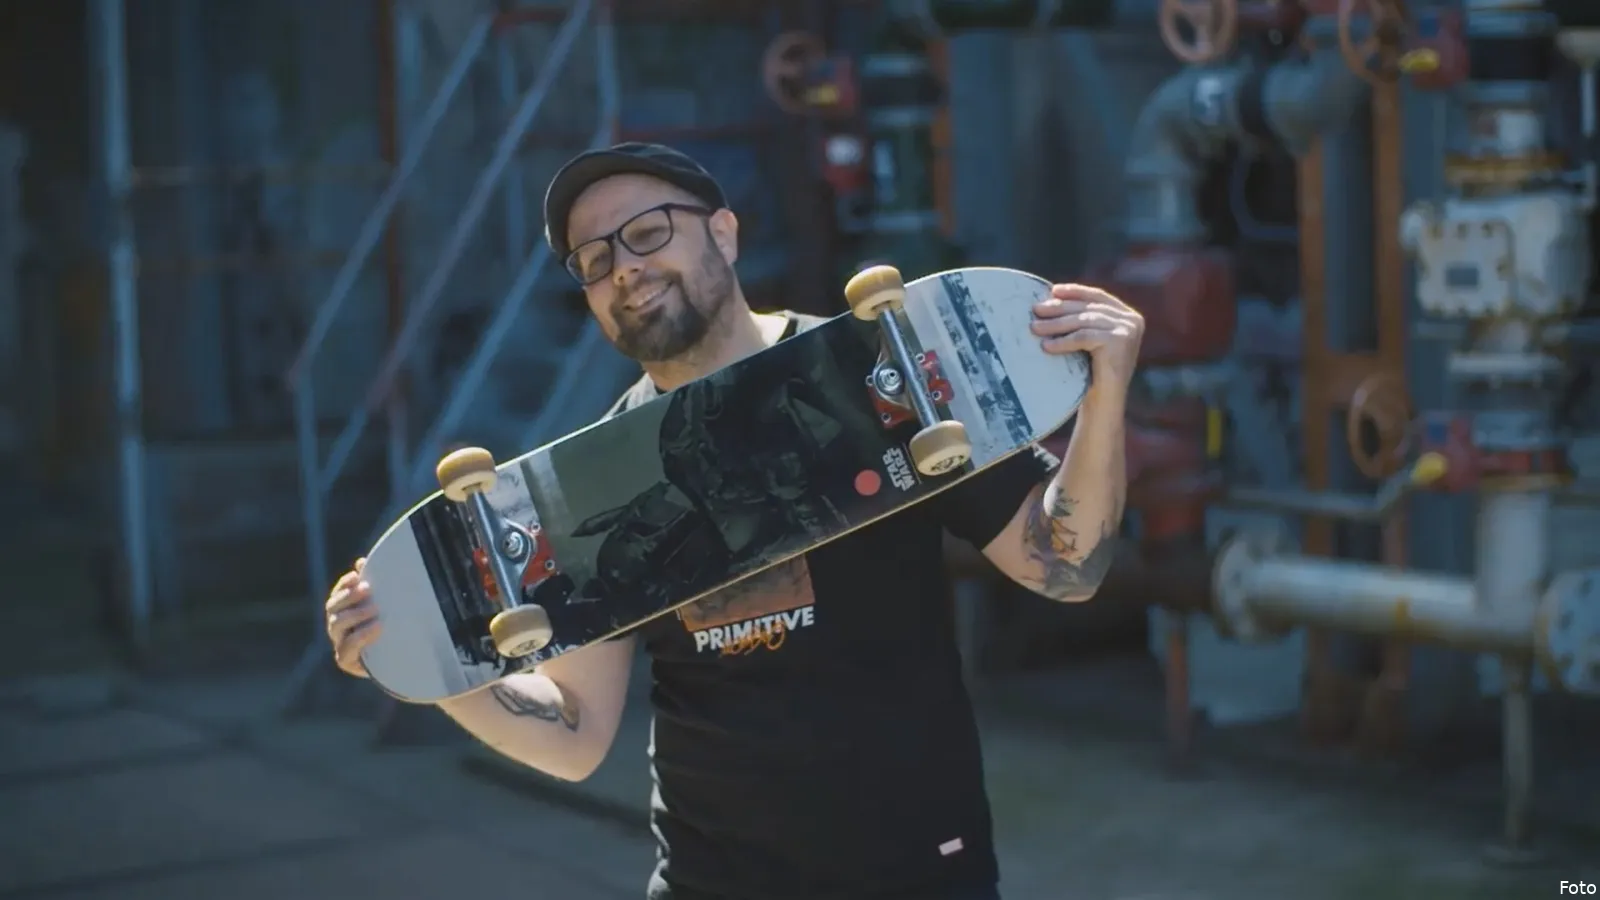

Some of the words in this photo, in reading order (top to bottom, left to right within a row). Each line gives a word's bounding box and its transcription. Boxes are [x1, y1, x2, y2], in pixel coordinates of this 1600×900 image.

[882, 449, 902, 488] STAR
[891, 447, 915, 491] WARS
[693, 606, 815, 652] PRIMITIVE
